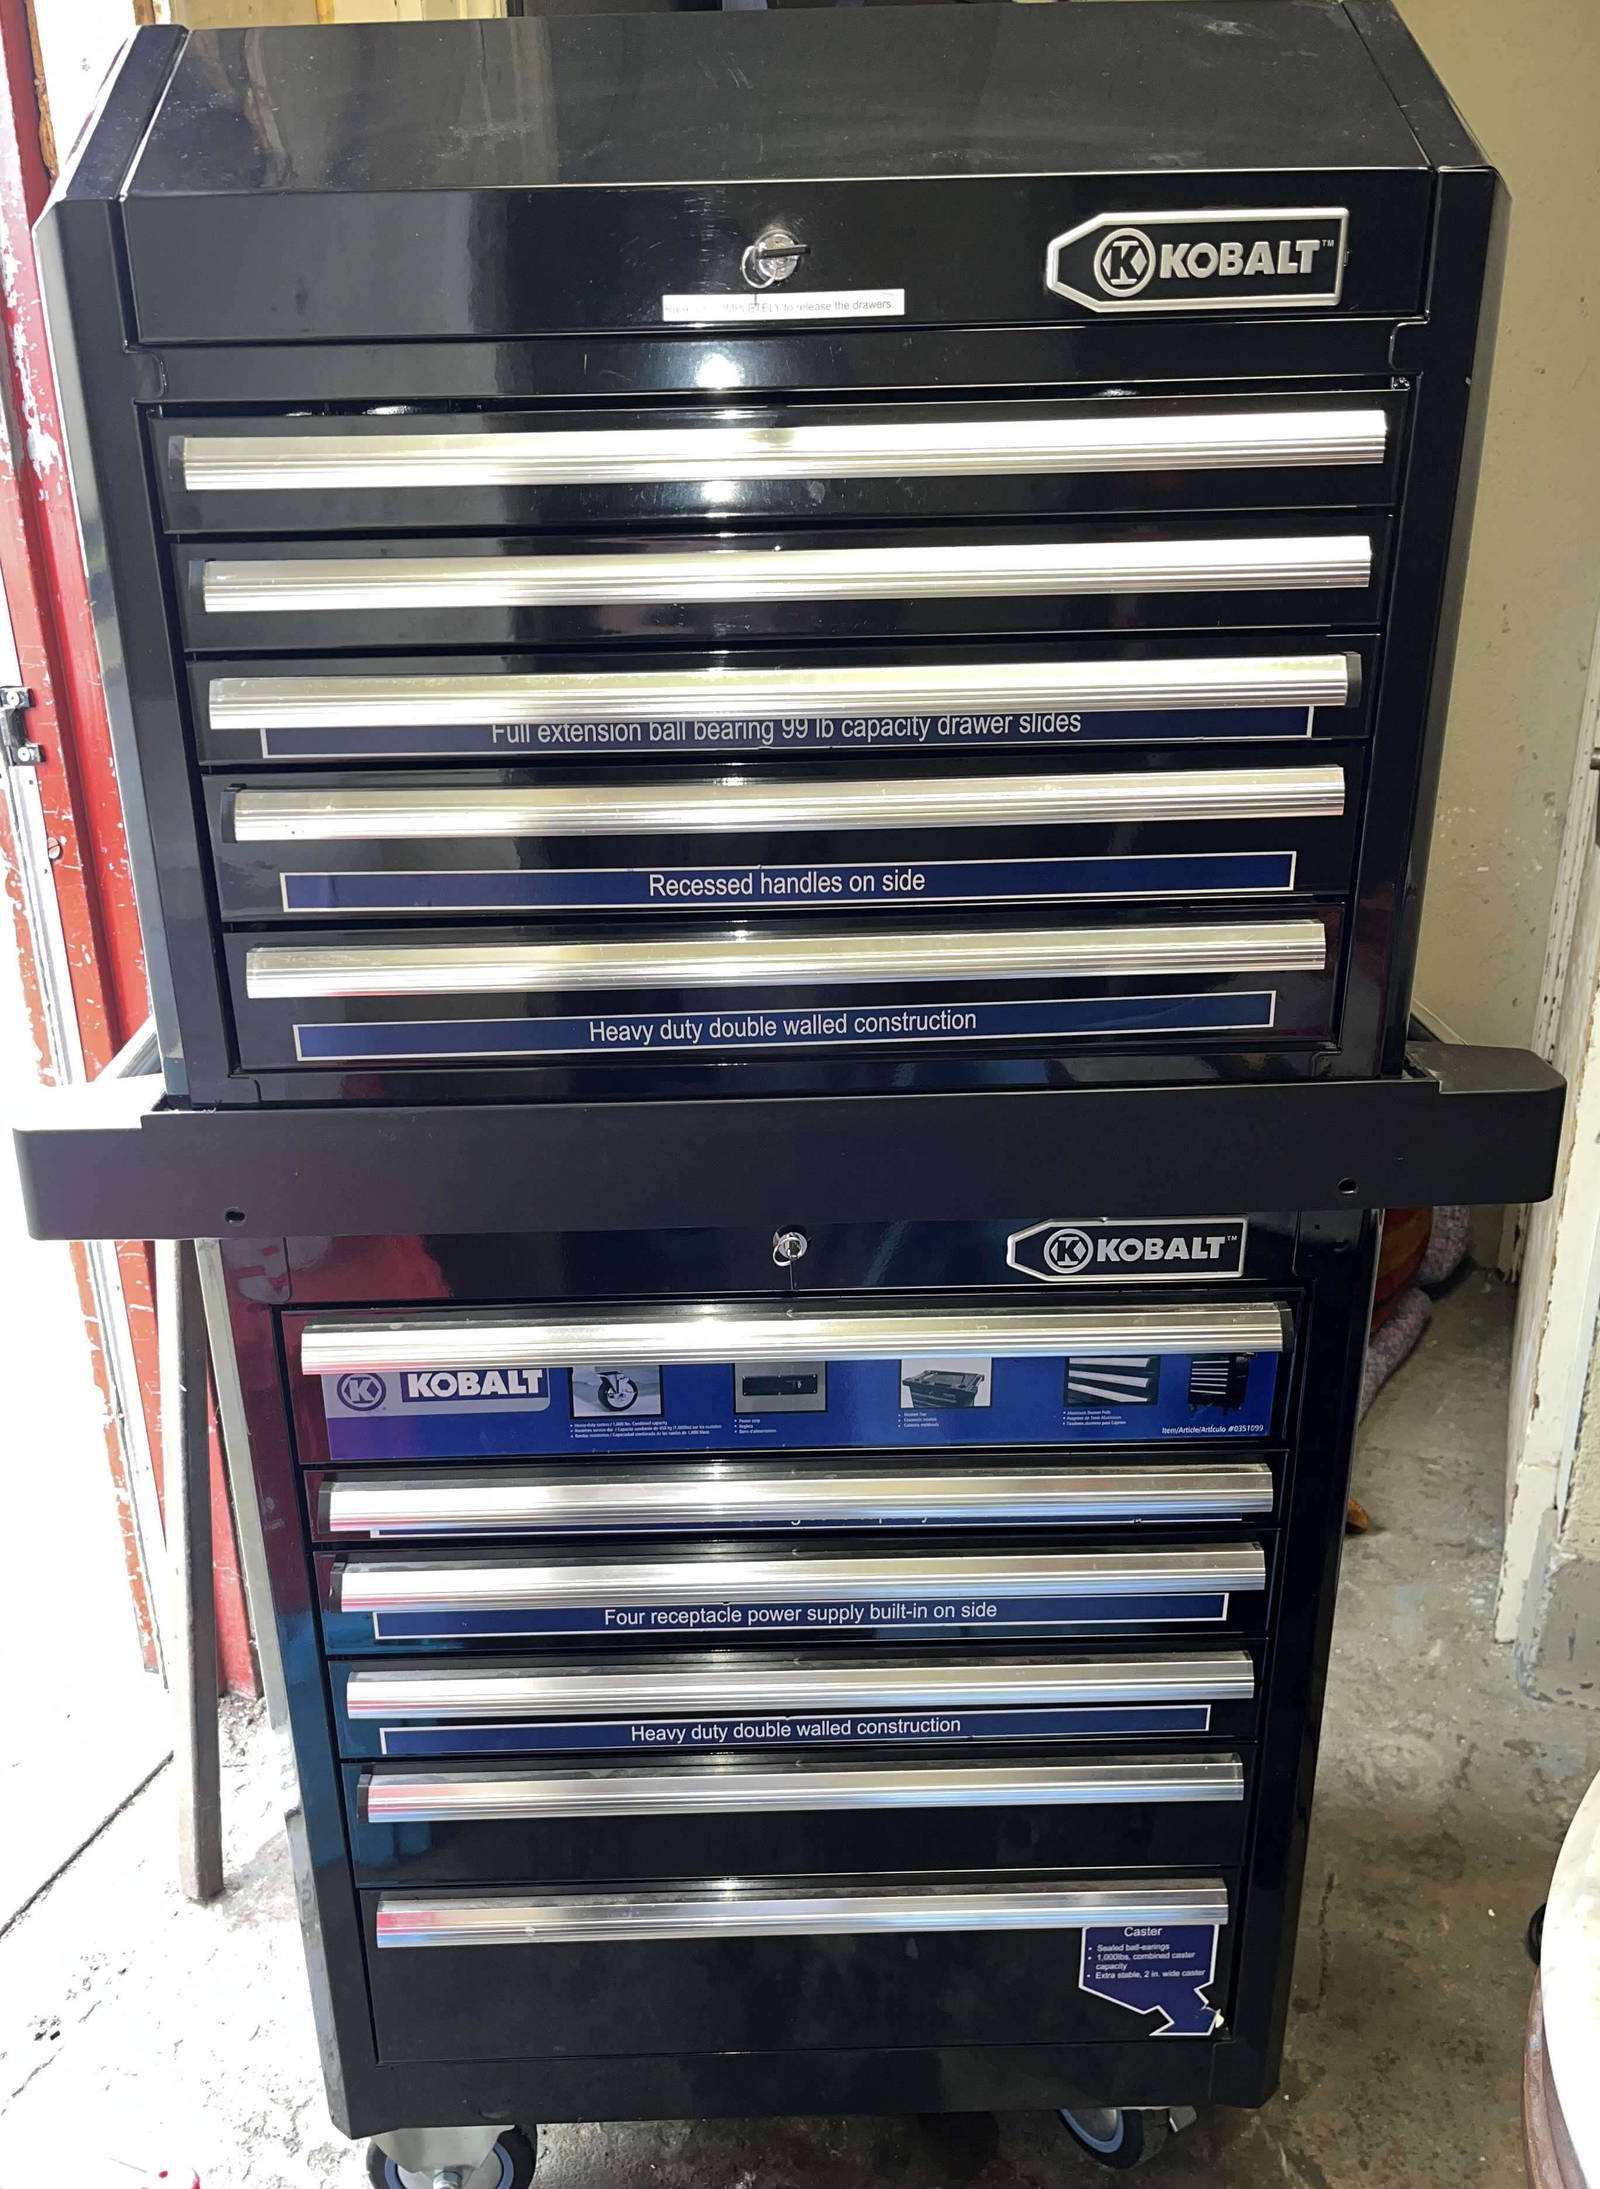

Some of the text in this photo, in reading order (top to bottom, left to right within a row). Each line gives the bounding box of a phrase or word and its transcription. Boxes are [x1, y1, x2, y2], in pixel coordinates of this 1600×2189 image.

[1160, 240, 1320, 279] KOBALT
[835, 299, 850, 310] the
[491, 713, 1081, 745] Full extension ball bearing 99 lb capacity drawer slides
[649, 869, 926, 896] Recessed handles on side
[589, 1010, 977, 1045] Heavy duty double walled construction
[1096, 1236, 1226, 1262] KOBALT
[407, 1369, 543, 1398] KOBALT
[604, 1602, 997, 1627] Four receptacle power supply built-in on side
[631, 1718, 961, 1744] Heavy duty double walled construction
[1124, 1926, 1163, 1937] Caster
[1096, 1963, 1128, 1971] capacity
[1133, 1952, 1170, 1960] combined
[1171, 1951, 1196, 1959] caster
[1095, 1971, 1115, 1979] Extra
[1162, 1969, 1180, 1977] wide
